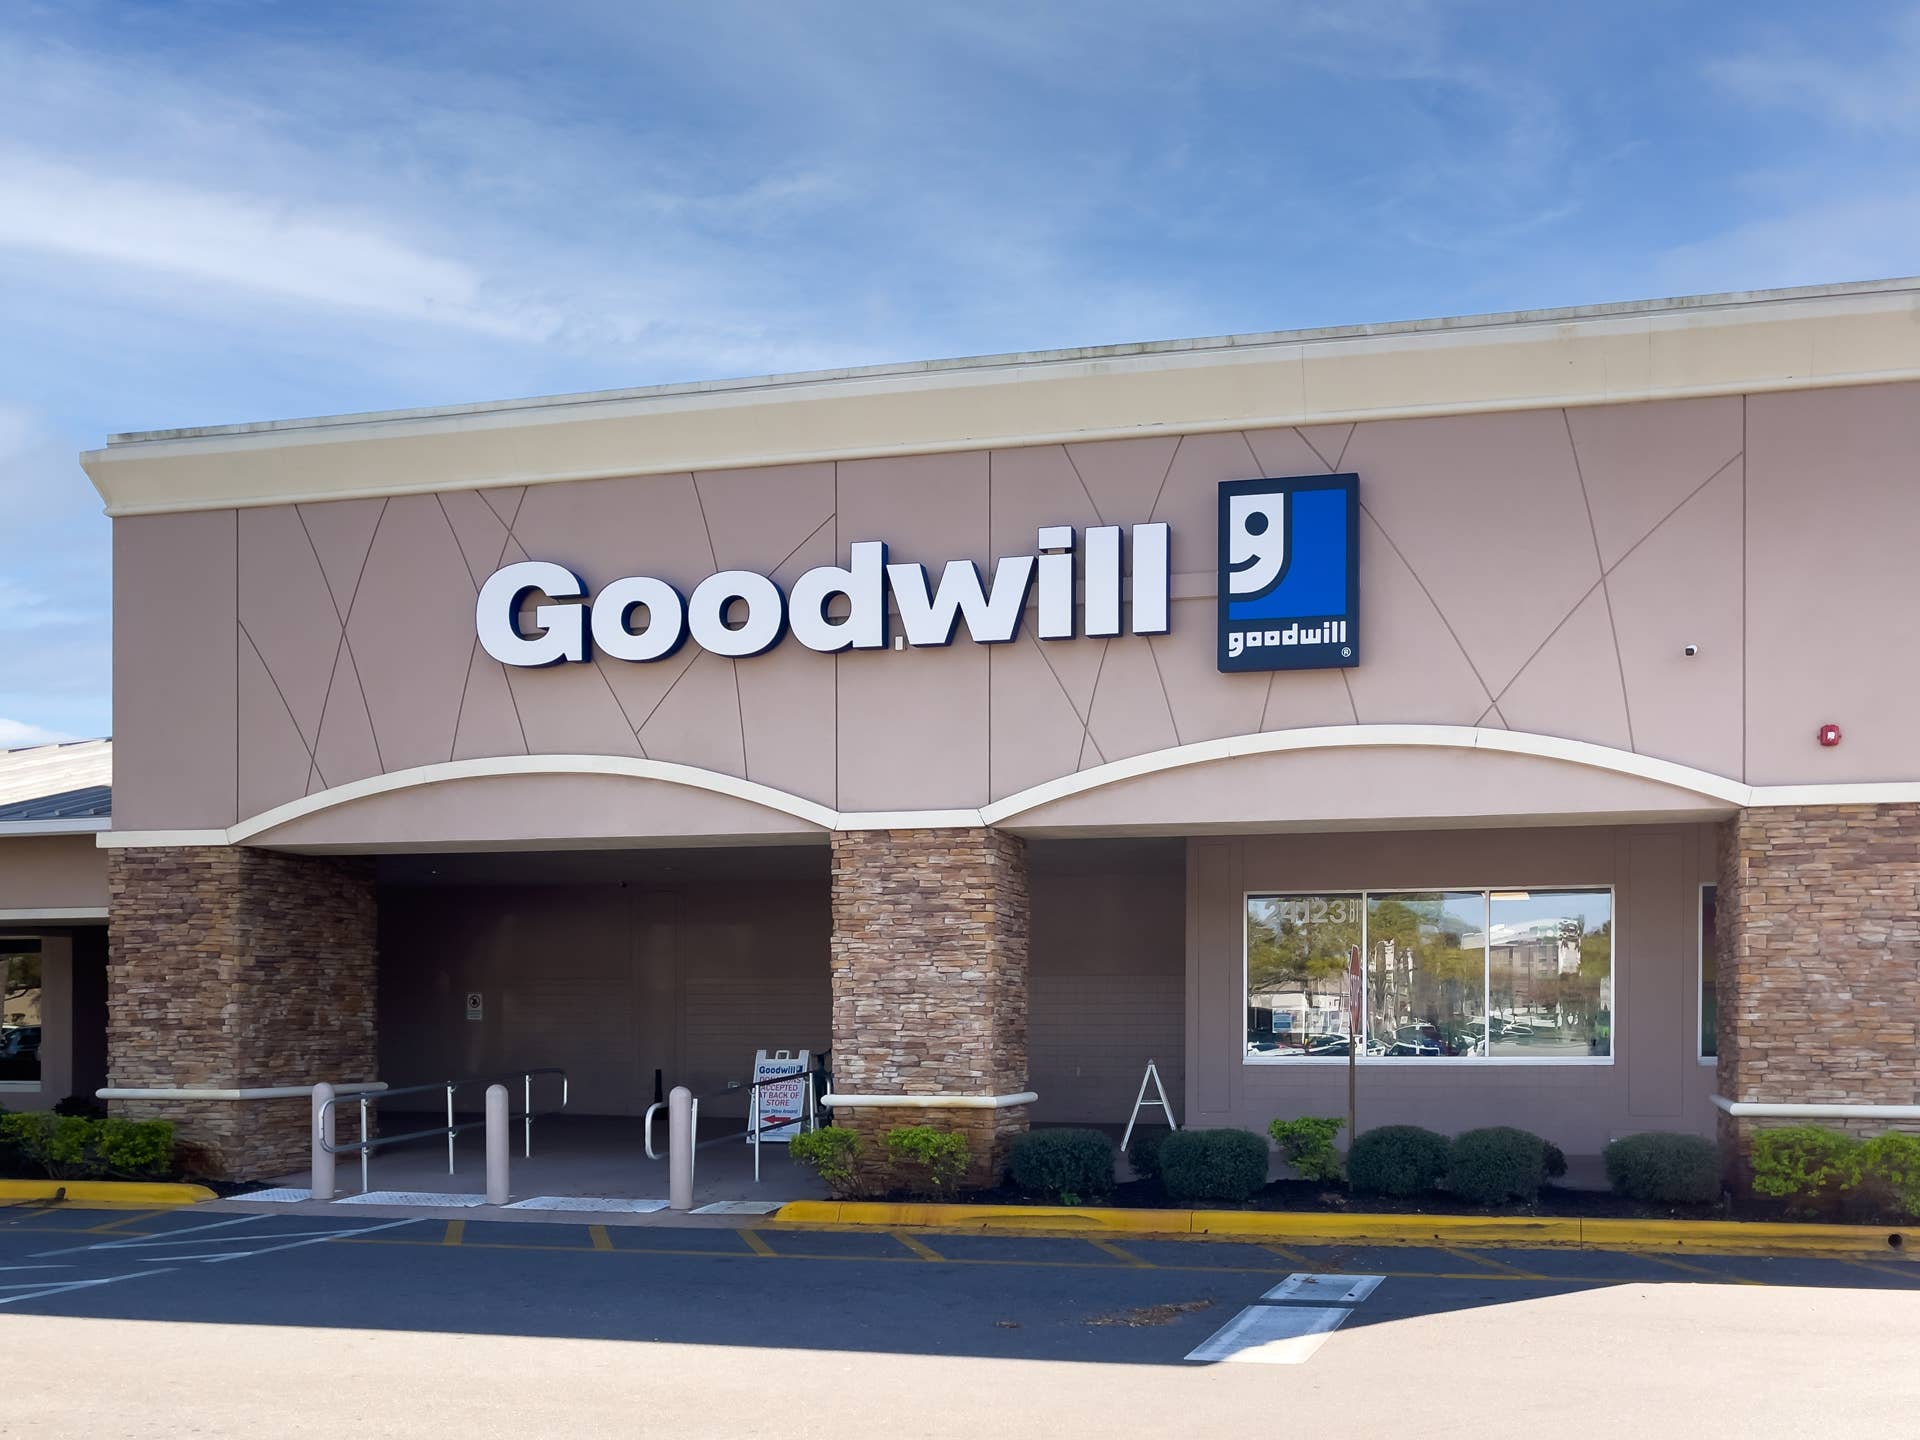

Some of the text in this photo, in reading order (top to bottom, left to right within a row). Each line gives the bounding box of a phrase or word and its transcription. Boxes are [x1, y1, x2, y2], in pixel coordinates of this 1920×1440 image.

[475, 522, 1171, 668] Goodwill
[1228, 620, 1347, 658] goodwill
[759, 1065, 796, 1074] Goodwill
[760, 1084, 798, 1092] ACCEPTED
